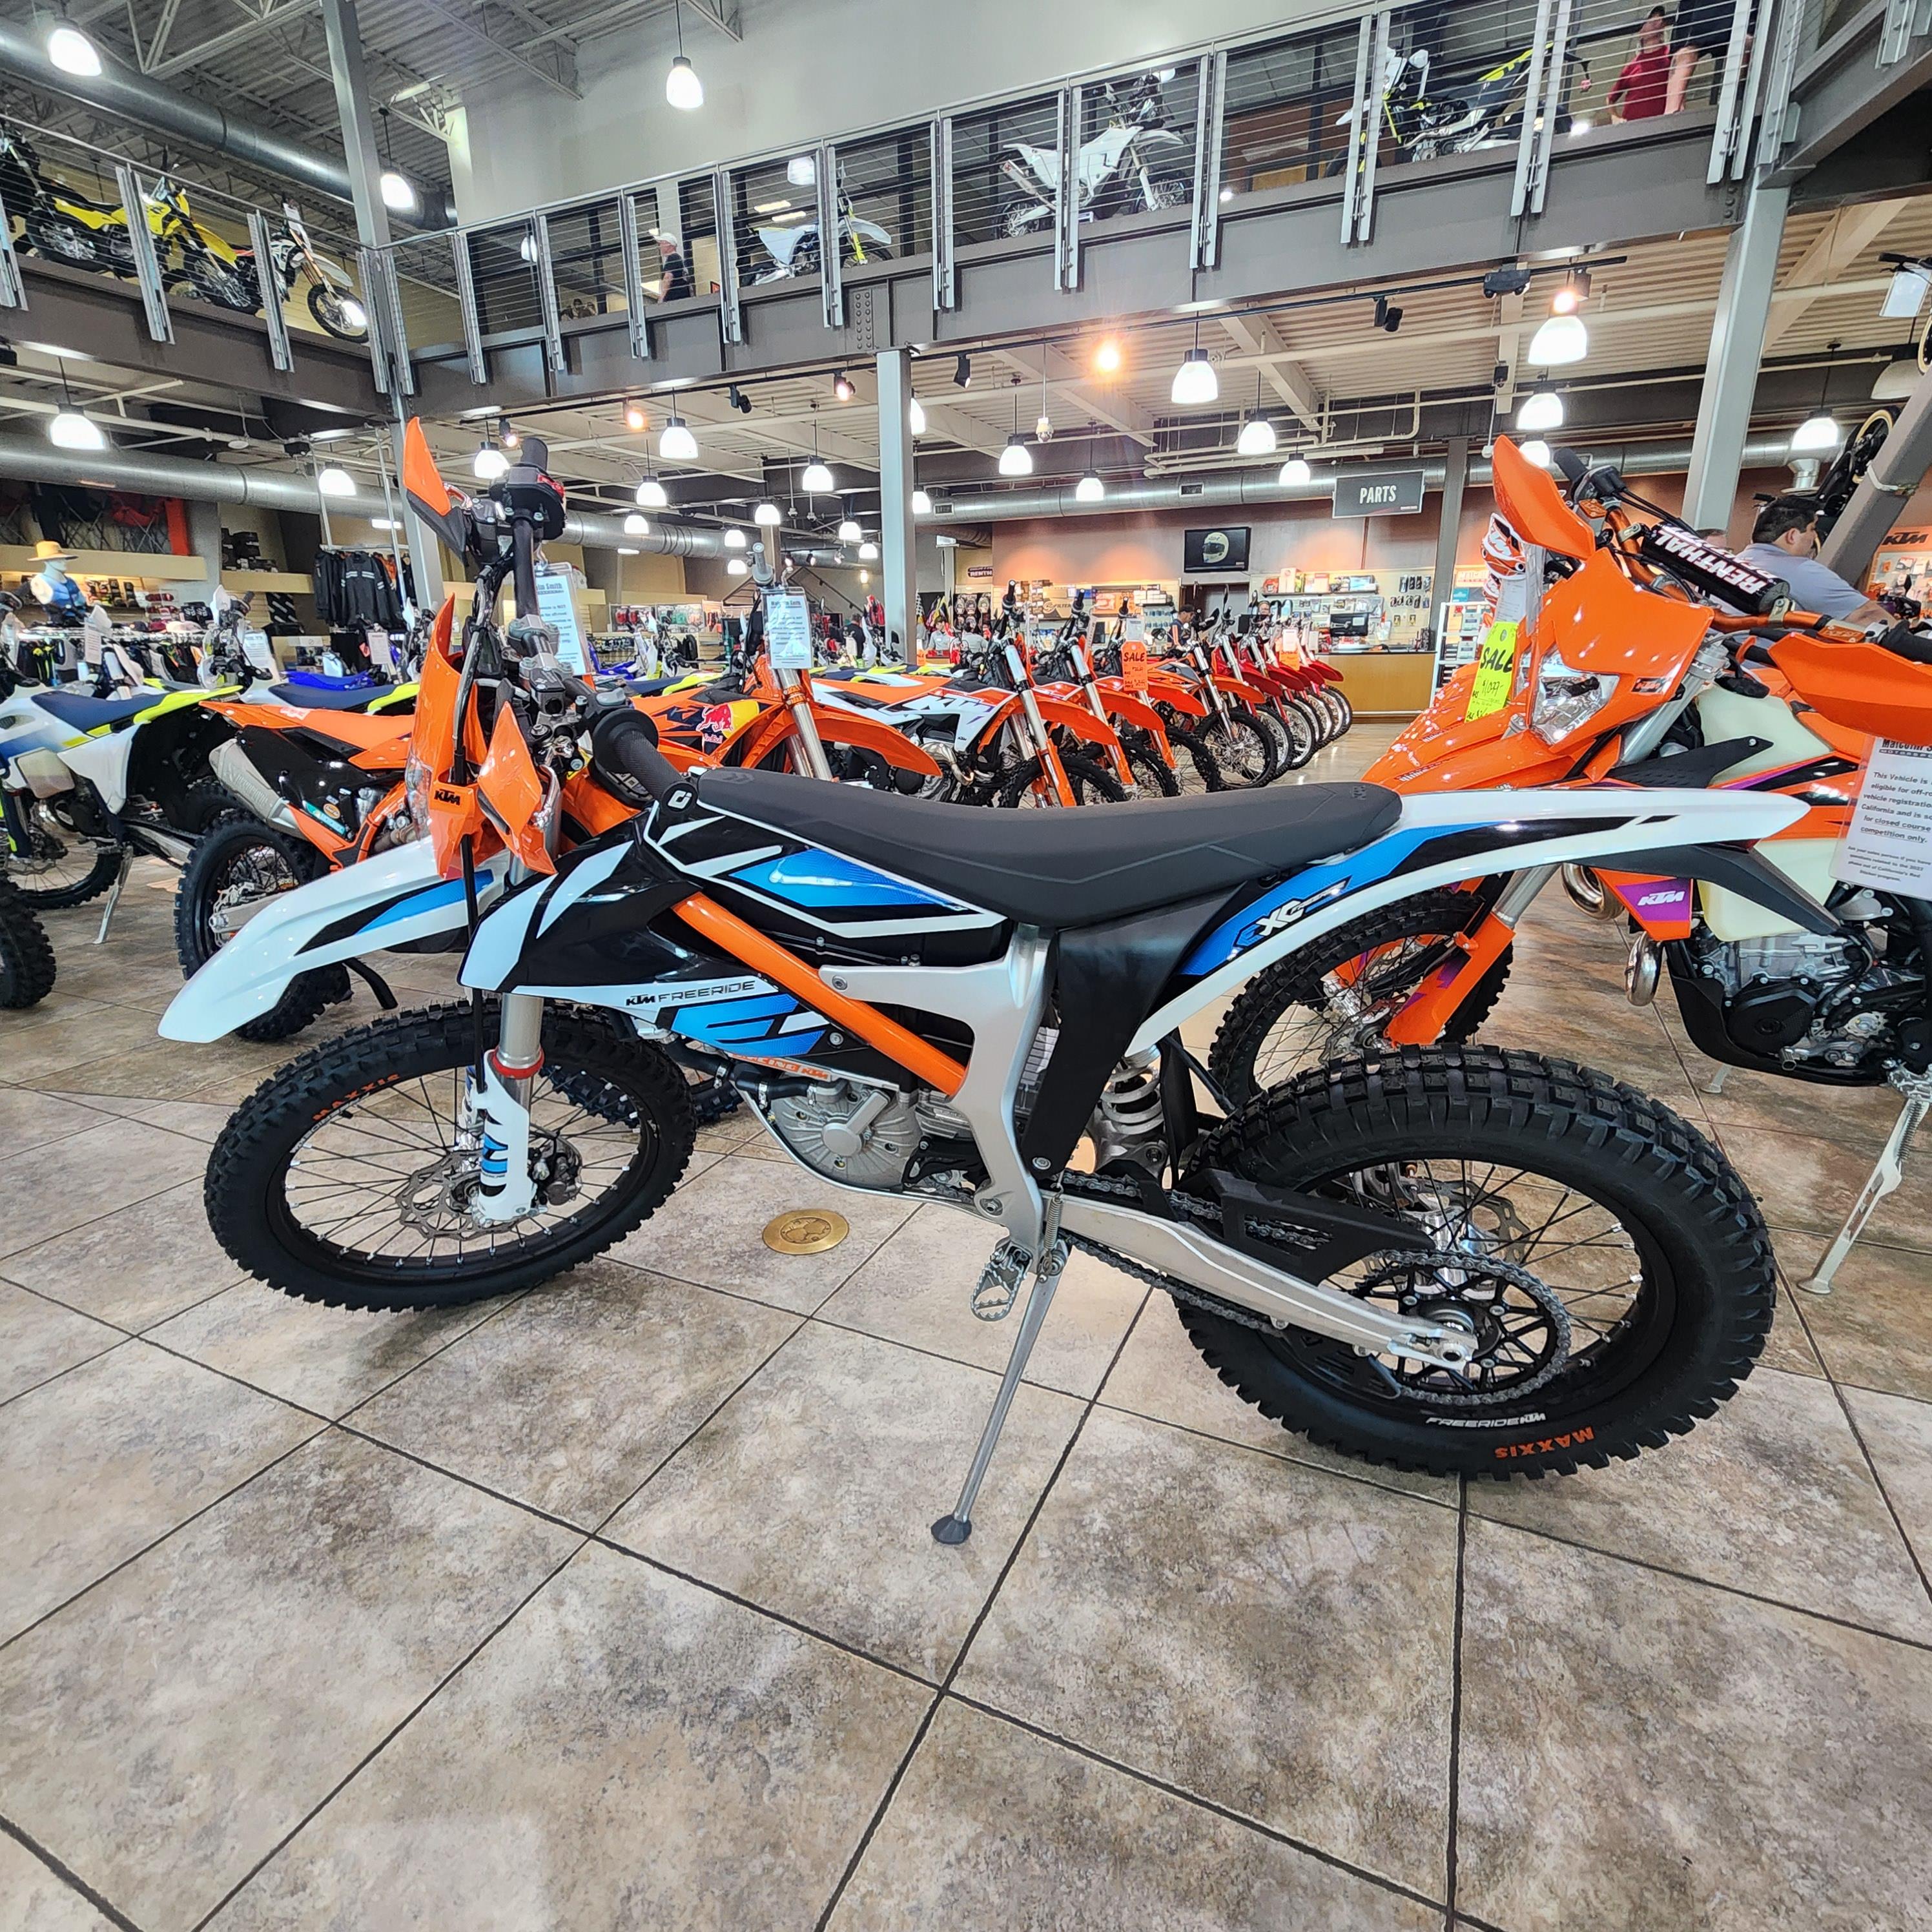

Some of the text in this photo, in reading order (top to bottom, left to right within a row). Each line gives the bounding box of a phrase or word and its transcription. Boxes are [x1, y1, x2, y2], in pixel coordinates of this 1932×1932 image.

[1359, 485, 1397, 504] PARTS
[1881, 531, 1929, 546] KTM
[1654, 529, 1769, 588] RENTHAL
[1124, 652, 1146, 663] SALE
[1890, 774, 1918, 783] Vehicle
[1871, 783, 1896, 792] eligible
[434, 788, 460, 806] KTM
[1861, 803, 1895, 814] California
[1875, 817, 1901, 827] closed
[1902, 822, 1931, 832] course
[1860, 827, 1928, 844] competition only.
[1638, 890, 1685, 906] KTM
[626, 980, 756, 1006] KTM FREERIDE
[801, 1067, 828, 1079] KTM
[1426, 1412, 1547, 1428] FREERIDE KTM
[1494, 1426, 1596, 1459] MAXXIS
